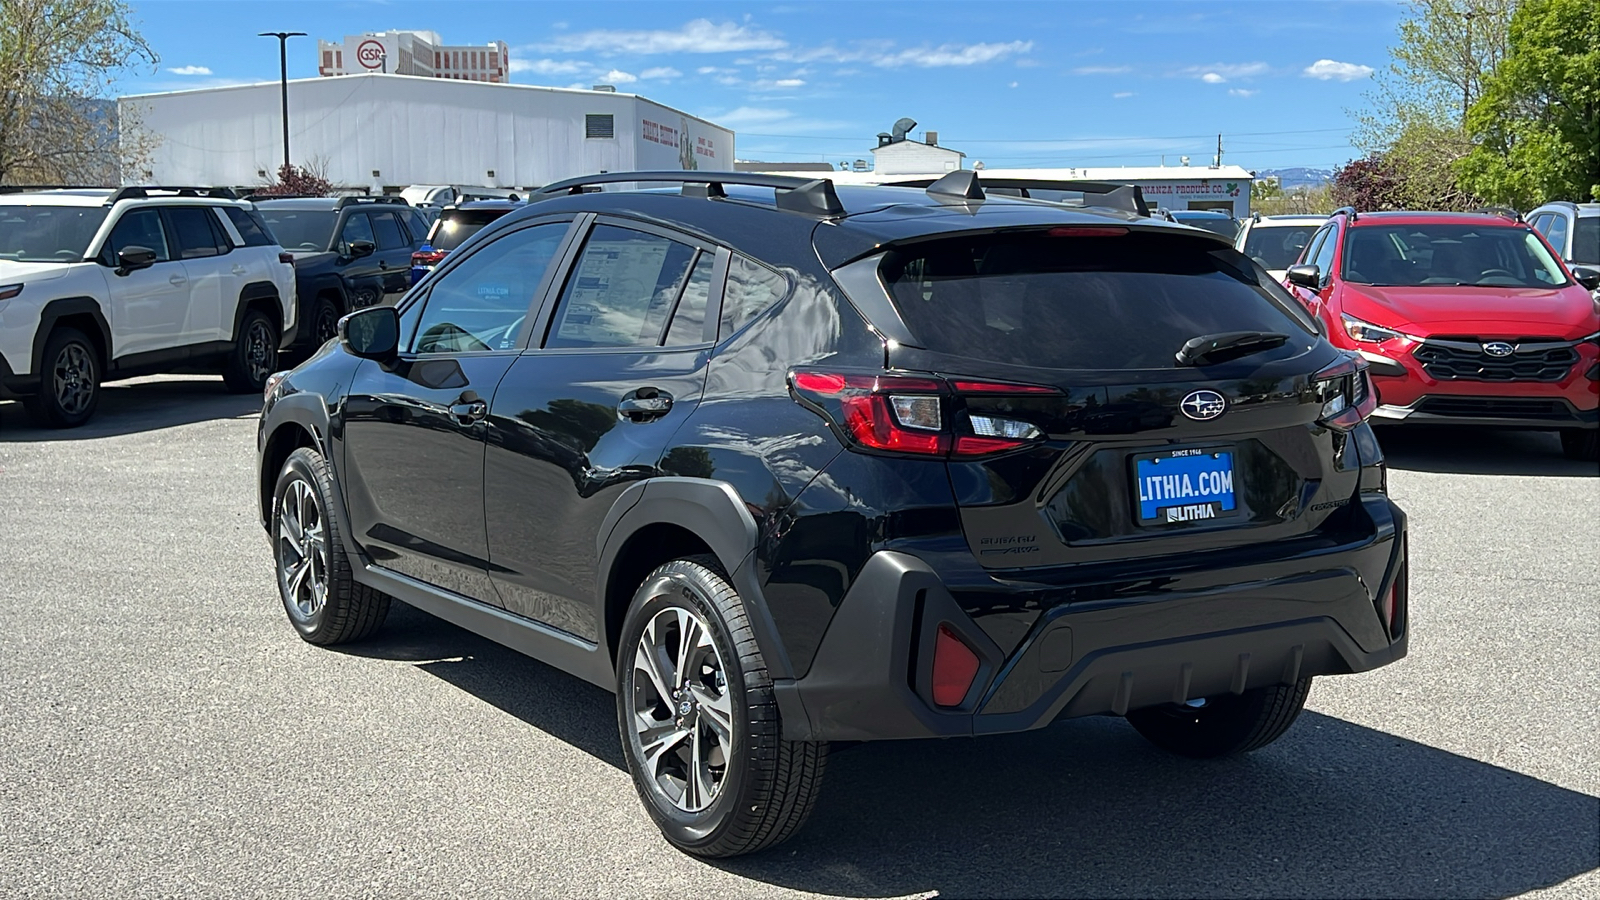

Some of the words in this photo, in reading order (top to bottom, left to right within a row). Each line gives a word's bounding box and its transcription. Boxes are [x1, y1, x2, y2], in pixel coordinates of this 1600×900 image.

[361, 48, 381, 60] GSR
[1176, 185, 1210, 194] PRODUCE
[1212, 185, 1225, 194] CO.
[1171, 449, 1188, 457] SINCE
[1138, 470, 1234, 501] LITHIA.COM
[1177, 503, 1215, 521] LITHIA
